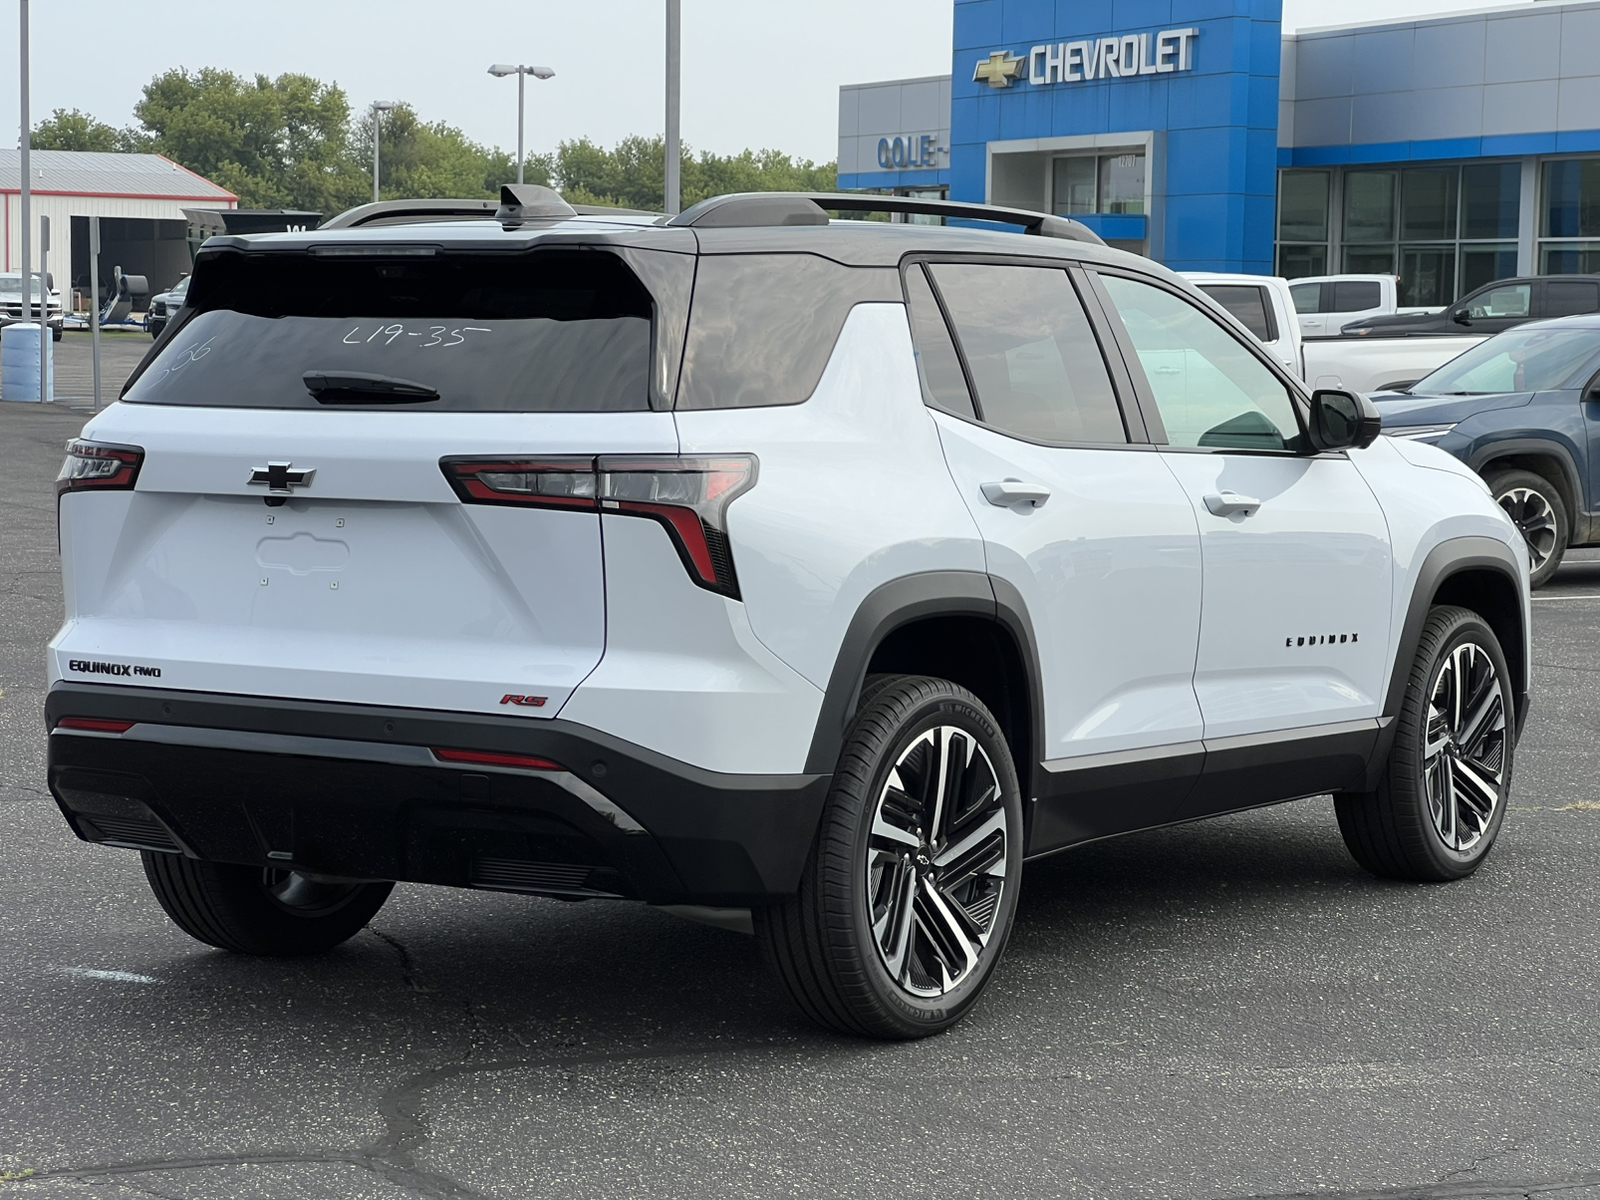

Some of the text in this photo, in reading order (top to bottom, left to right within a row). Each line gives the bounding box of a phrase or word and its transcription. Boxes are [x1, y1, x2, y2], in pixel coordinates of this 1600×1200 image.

[1029, 28, 1199, 85] CHEVROLET
[1118, 154, 1136, 168] 12707
[342, 323, 493, 347] L19-35
[1285, 633, 1359, 648] EQUINOX
[68, 659, 161, 678] EQUINOX AWD
[499, 693, 549, 707] RS
[953, 703, 994, 737] MICHELIN
